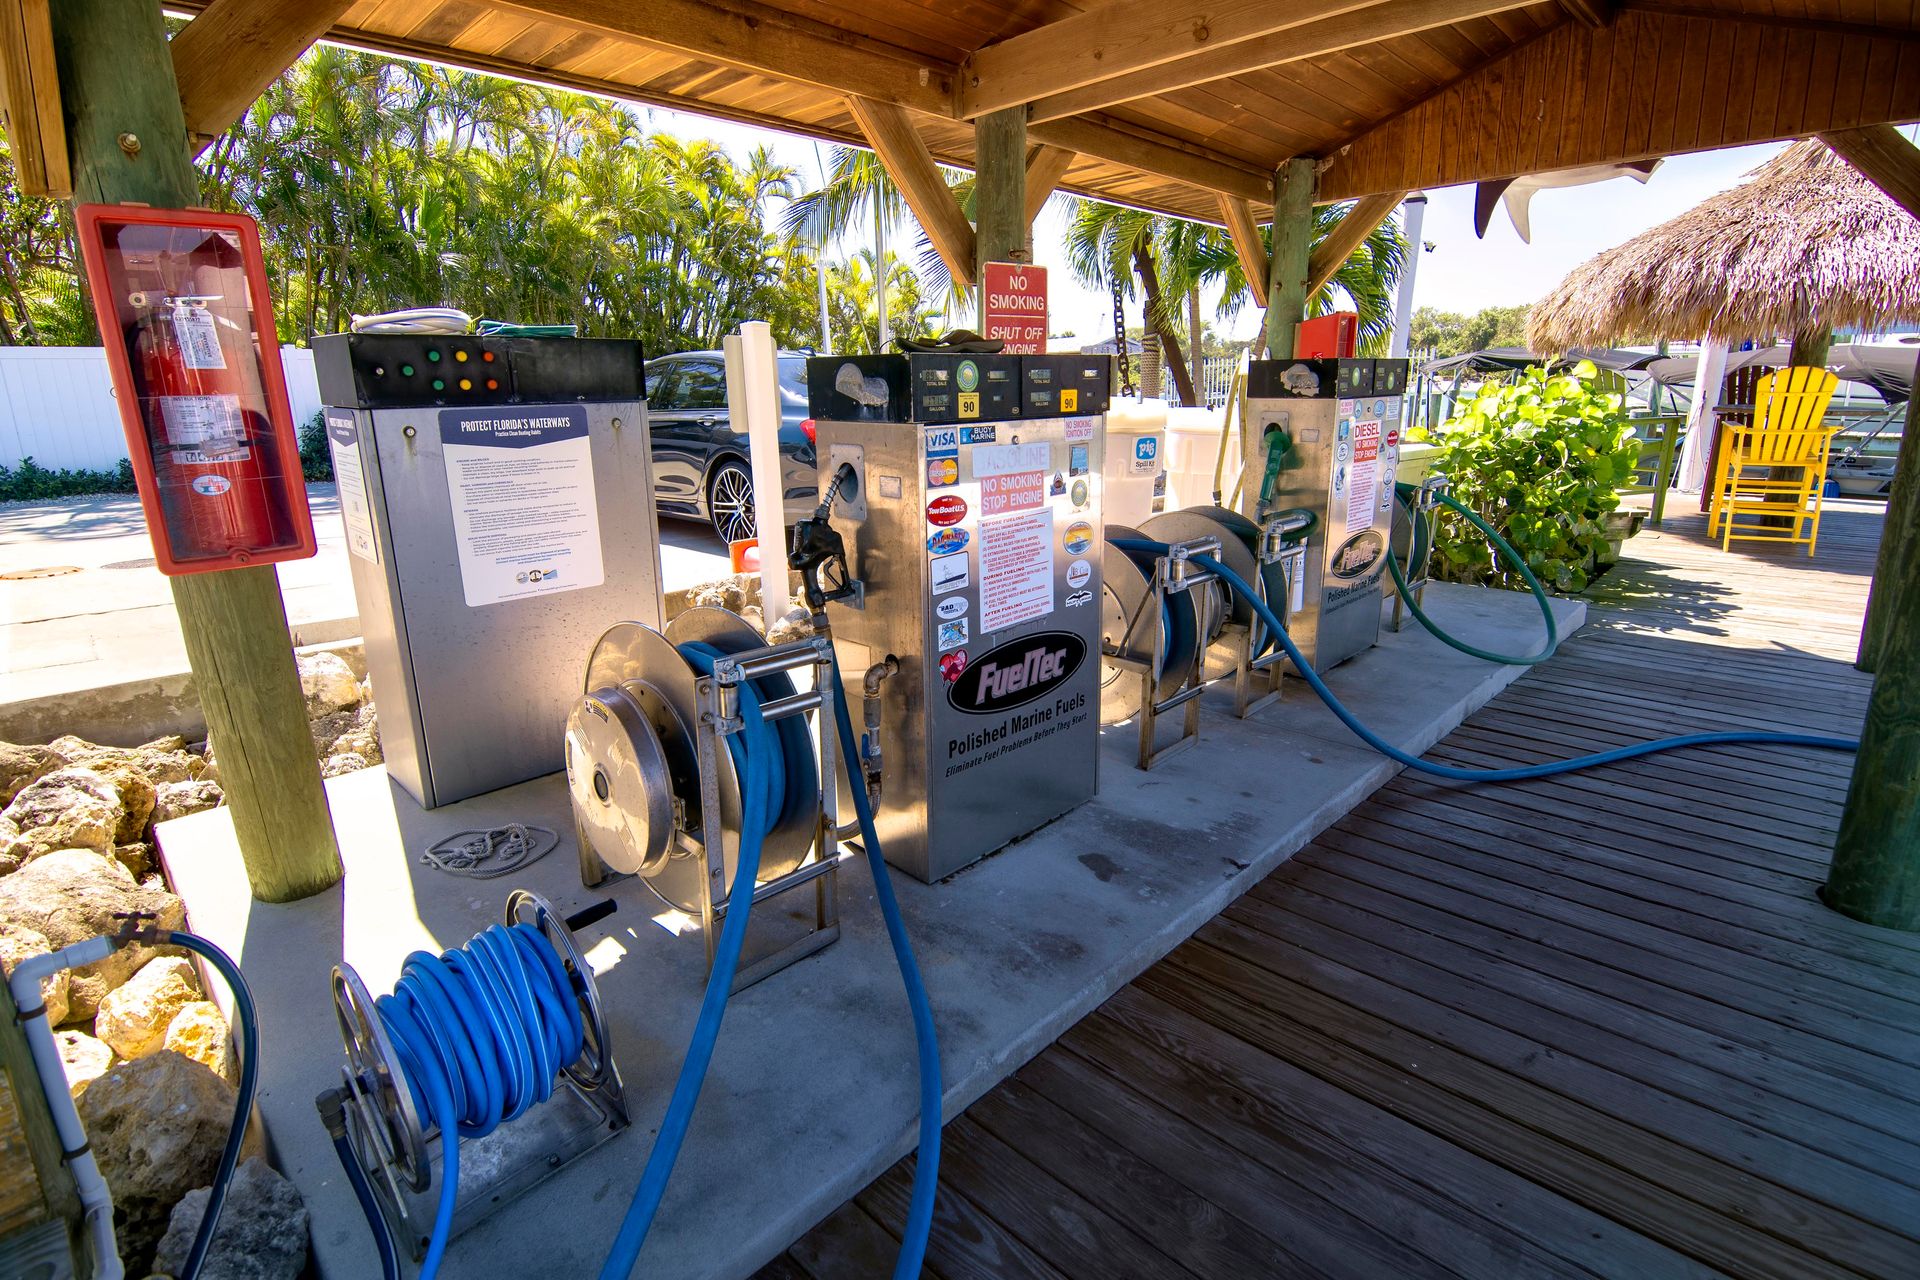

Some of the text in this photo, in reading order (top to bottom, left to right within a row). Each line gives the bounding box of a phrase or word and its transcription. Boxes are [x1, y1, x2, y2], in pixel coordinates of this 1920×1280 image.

[1009, 275, 1027, 291] NO
[989, 293, 1045, 311] SMOKING
[990, 326, 1044, 340] SHUT OFF
[963, 401, 975, 413] 90
[1064, 399, 1074, 409] 90
[460, 417, 571, 433] PROTECT FLORIDA'S WATERWAYS
[974, 426, 992, 434] BUOY
[1066, 419, 1091, 429] NO SMOKING
[1355, 423, 1379, 437] DIESEL
[930, 432, 956, 446] VISA
[1139, 440, 1155, 456] pig
[983, 473, 1042, 493] NO SMOKING
[983, 490, 1042, 510] STOP ENGINE
[983, 566, 1024, 580] DURING FUELING
[1328, 584, 1350, 604] Polished
[984, 602, 1022, 617] AFTER FUELING
[975, 646, 1067, 705] FuelTec
[949, 692, 1085, 759] Polished Marine Fuels
[945, 712, 1088, 778] Eliminate Fuel Problems Before They Start
